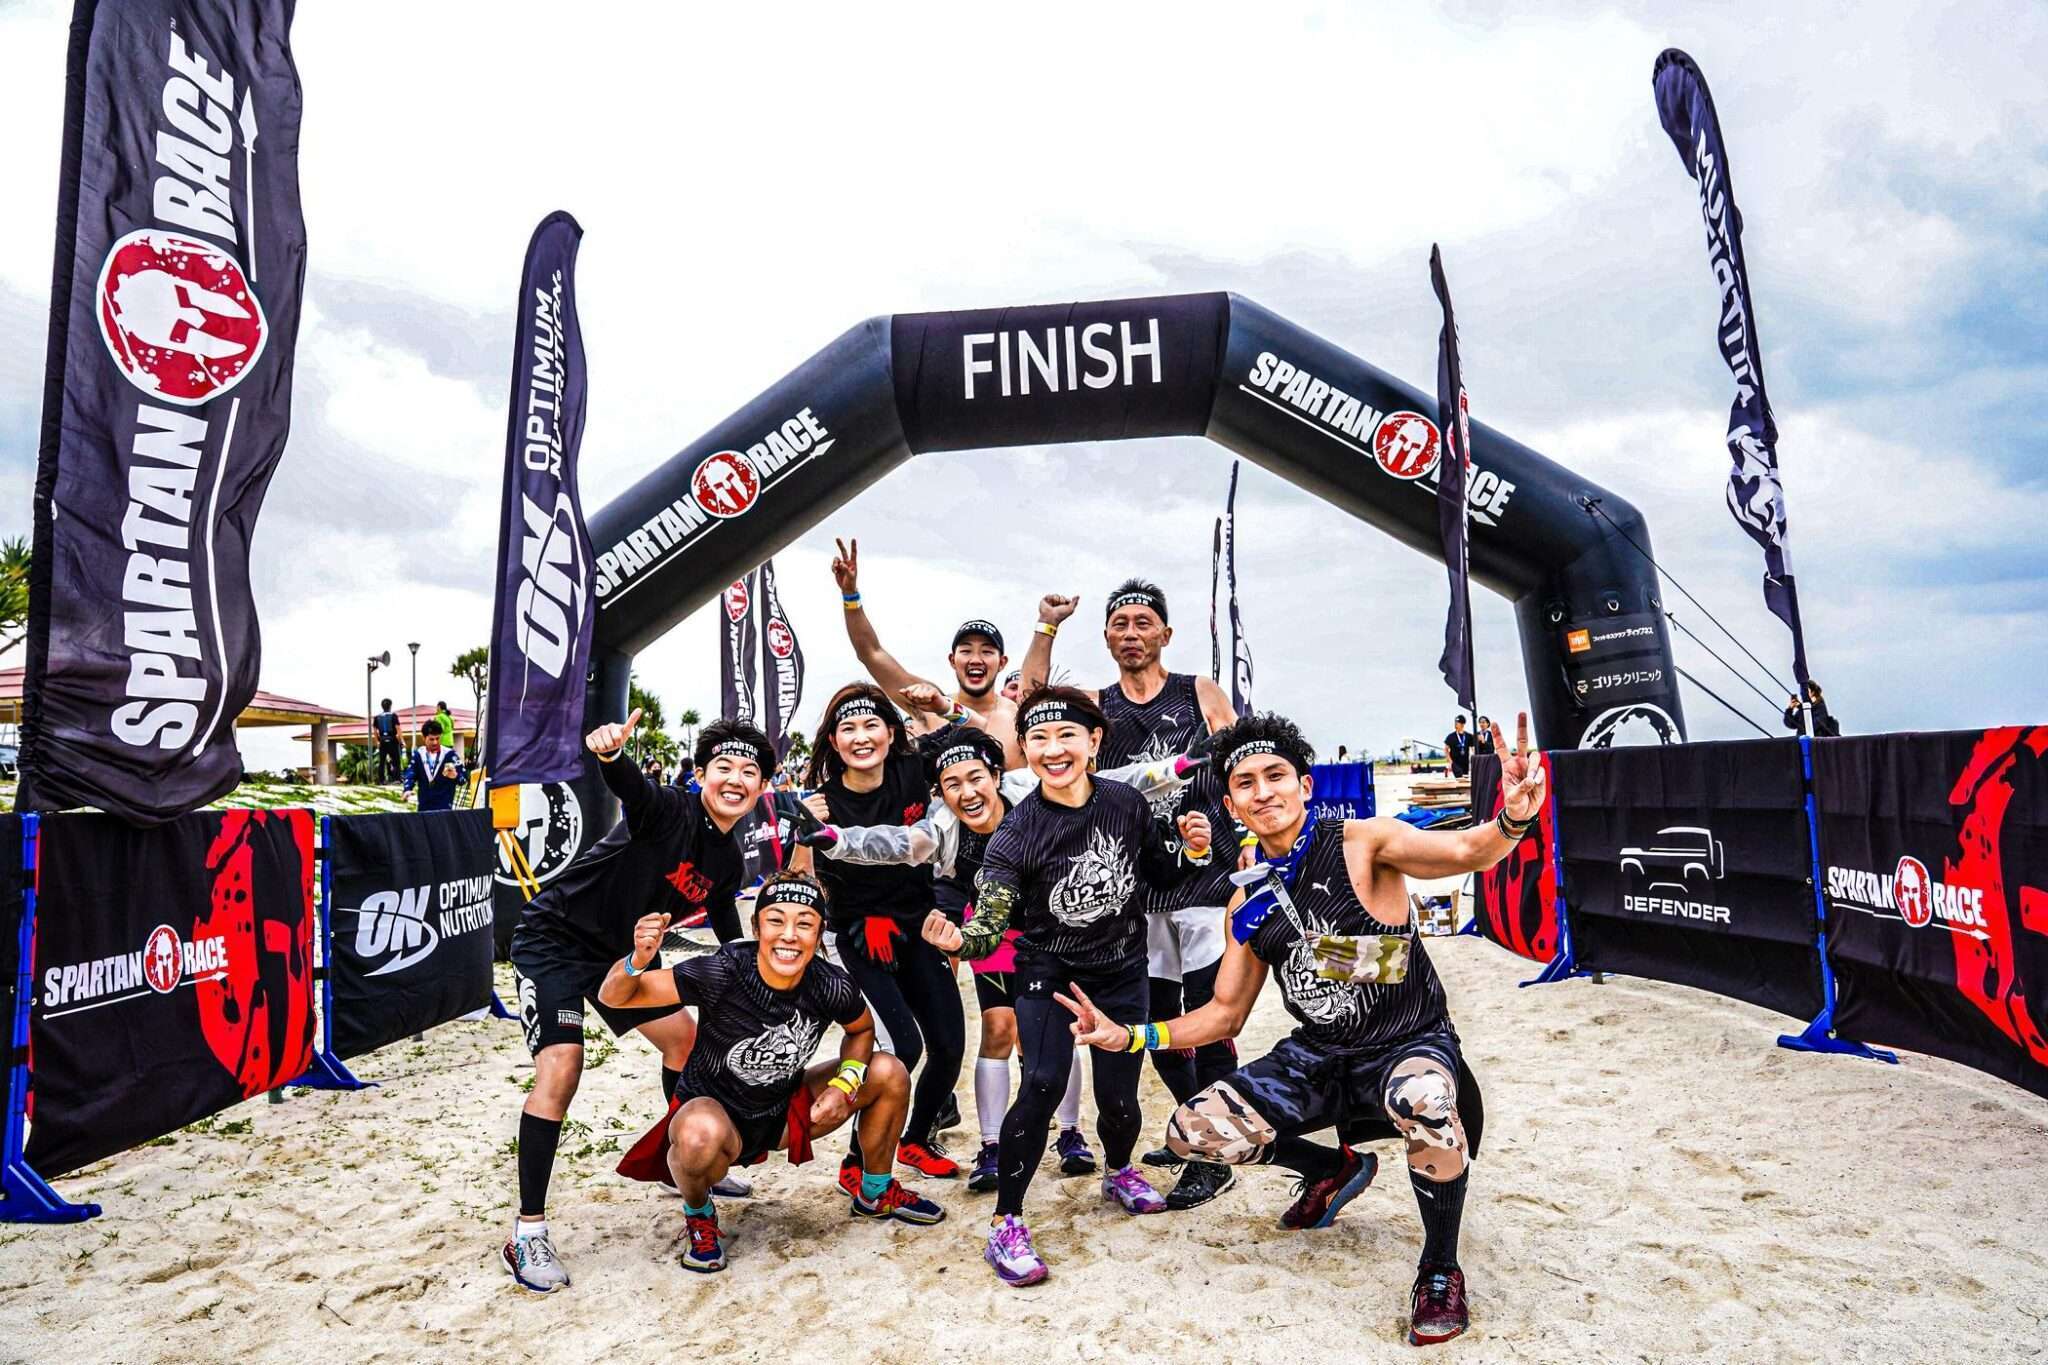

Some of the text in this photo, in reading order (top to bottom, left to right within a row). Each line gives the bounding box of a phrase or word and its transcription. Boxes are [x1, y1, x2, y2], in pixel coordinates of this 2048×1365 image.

[153, 31, 238, 246] RACE
[524, 288, 555, 472] OPTIMUM
[962, 318, 1163, 400] FINISH
[1249, 352, 1517, 518] SPARTAN CE
[594, 407, 829, 597] SPARTAN RACE
[110, 403, 208, 750] SPARTAN
[516, 493, 573, 679] ON
[1029, 701, 1067, 716] SPARTAN
[1592, 669, 1662, 690] ゴリラクリニック
[722, 741, 759, 756] SPARTAN
[1028, 711, 1062, 727] 20868
[355, 885, 431, 957] ON
[439, 874, 493, 910] OPTIMUM
[776, 893, 814, 905] 21487
[778, 883, 818, 899] SPARTAN
[1624, 895, 1731, 924] DEFENDER
[1827, 866, 1988, 927] SPARTAN RACE
[44, 935, 229, 1007] SPARTAN RACE
